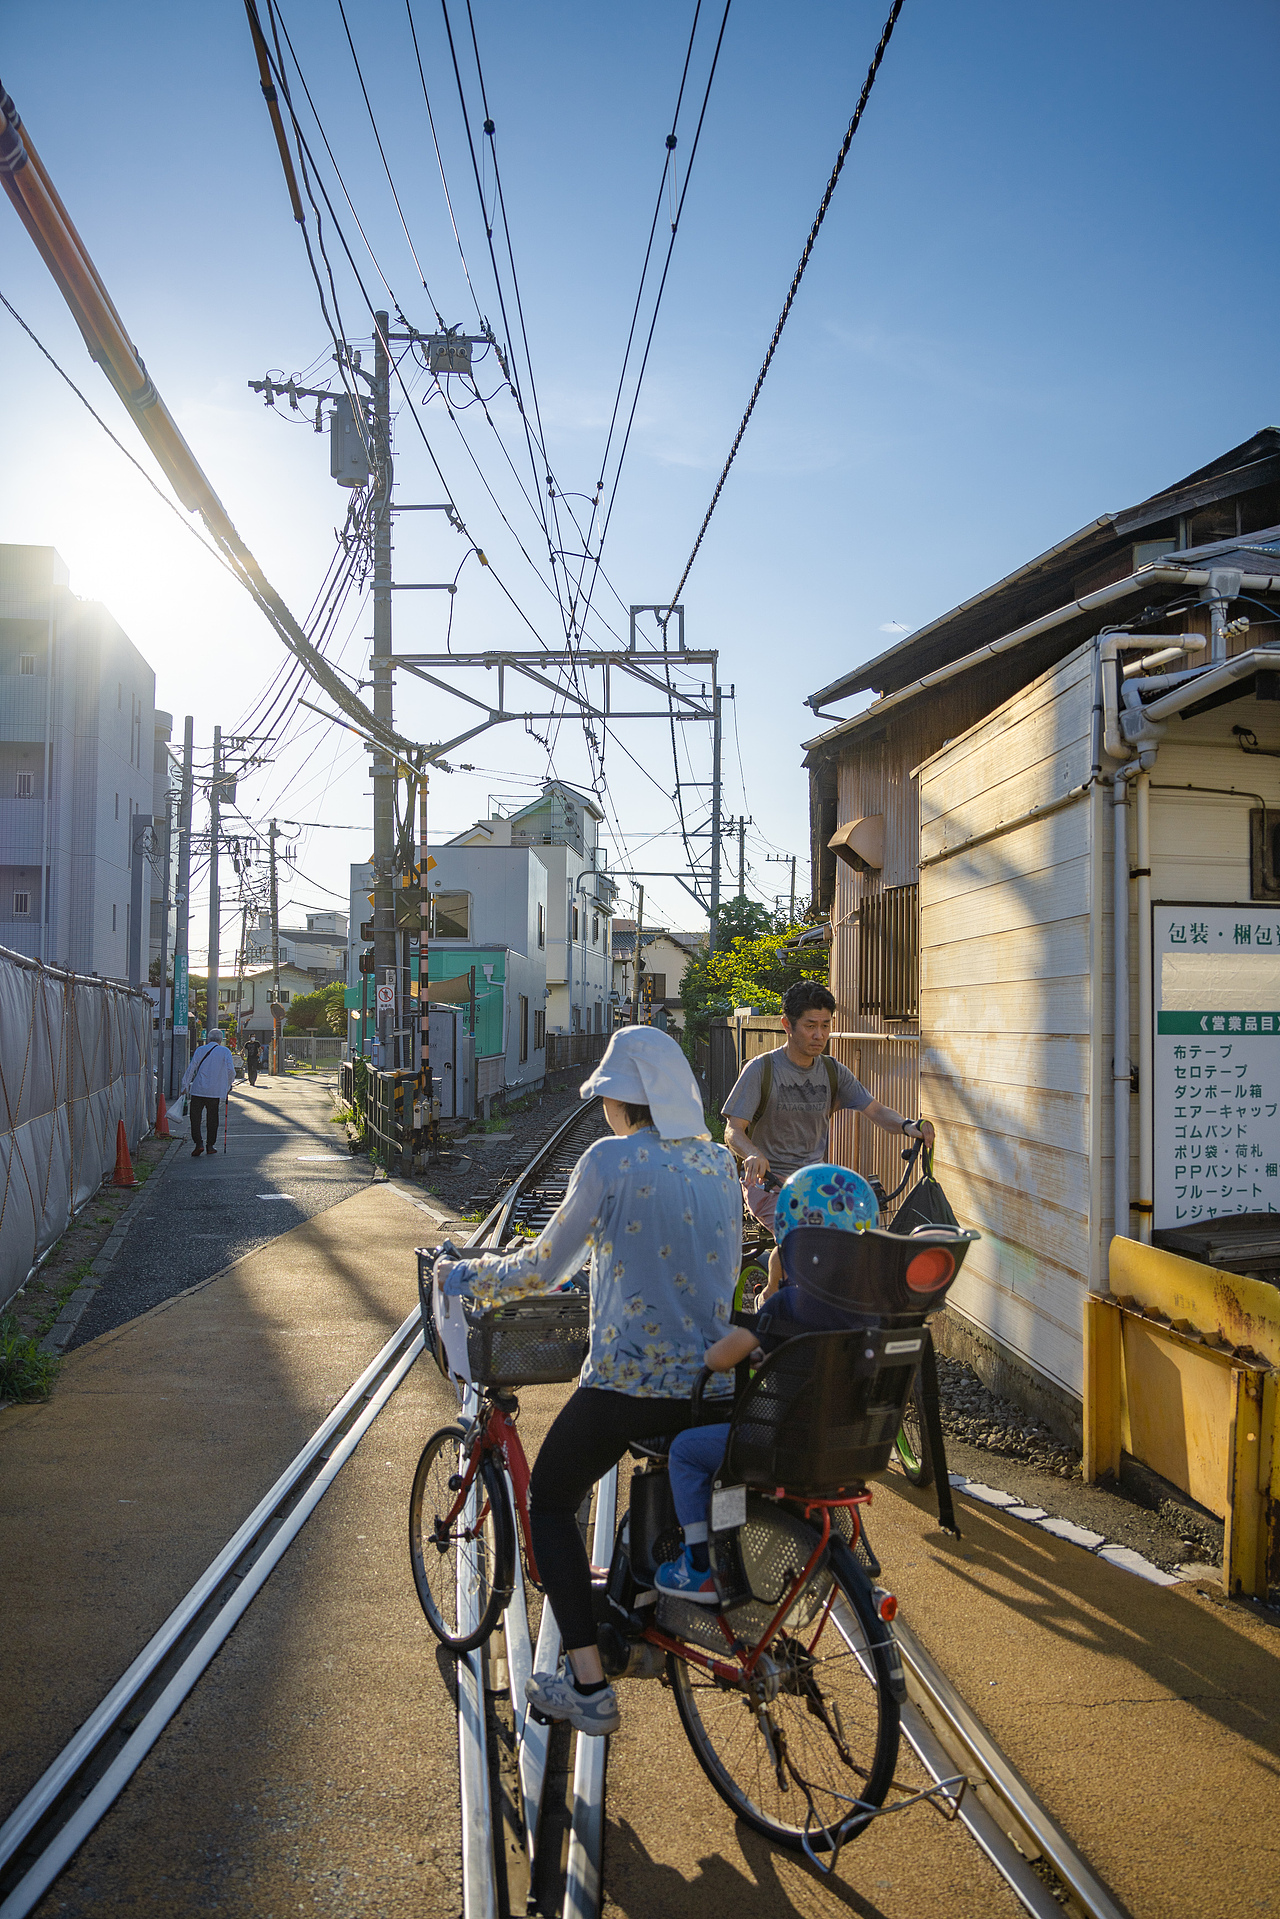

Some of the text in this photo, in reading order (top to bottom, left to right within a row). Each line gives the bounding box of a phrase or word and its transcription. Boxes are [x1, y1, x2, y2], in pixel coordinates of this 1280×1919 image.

[1174, 1044, 1233, 1060] 布テープ
[1174, 1064, 1248, 1079] セロテープ
[1174, 1084, 1262, 1099] ダンボール箱
[1174, 1103, 1278, 1119] エアーキャップ
[1174, 1124, 1248, 1139] ゴムバンド
[1174, 1144, 1263, 1159] ポリ袋・荷札
[1175, 1163, 1280, 1179] PPバンド・梱
[1175, 1183, 1262, 1199] ブルーシート
[552, 1693, 563, 1704] N
